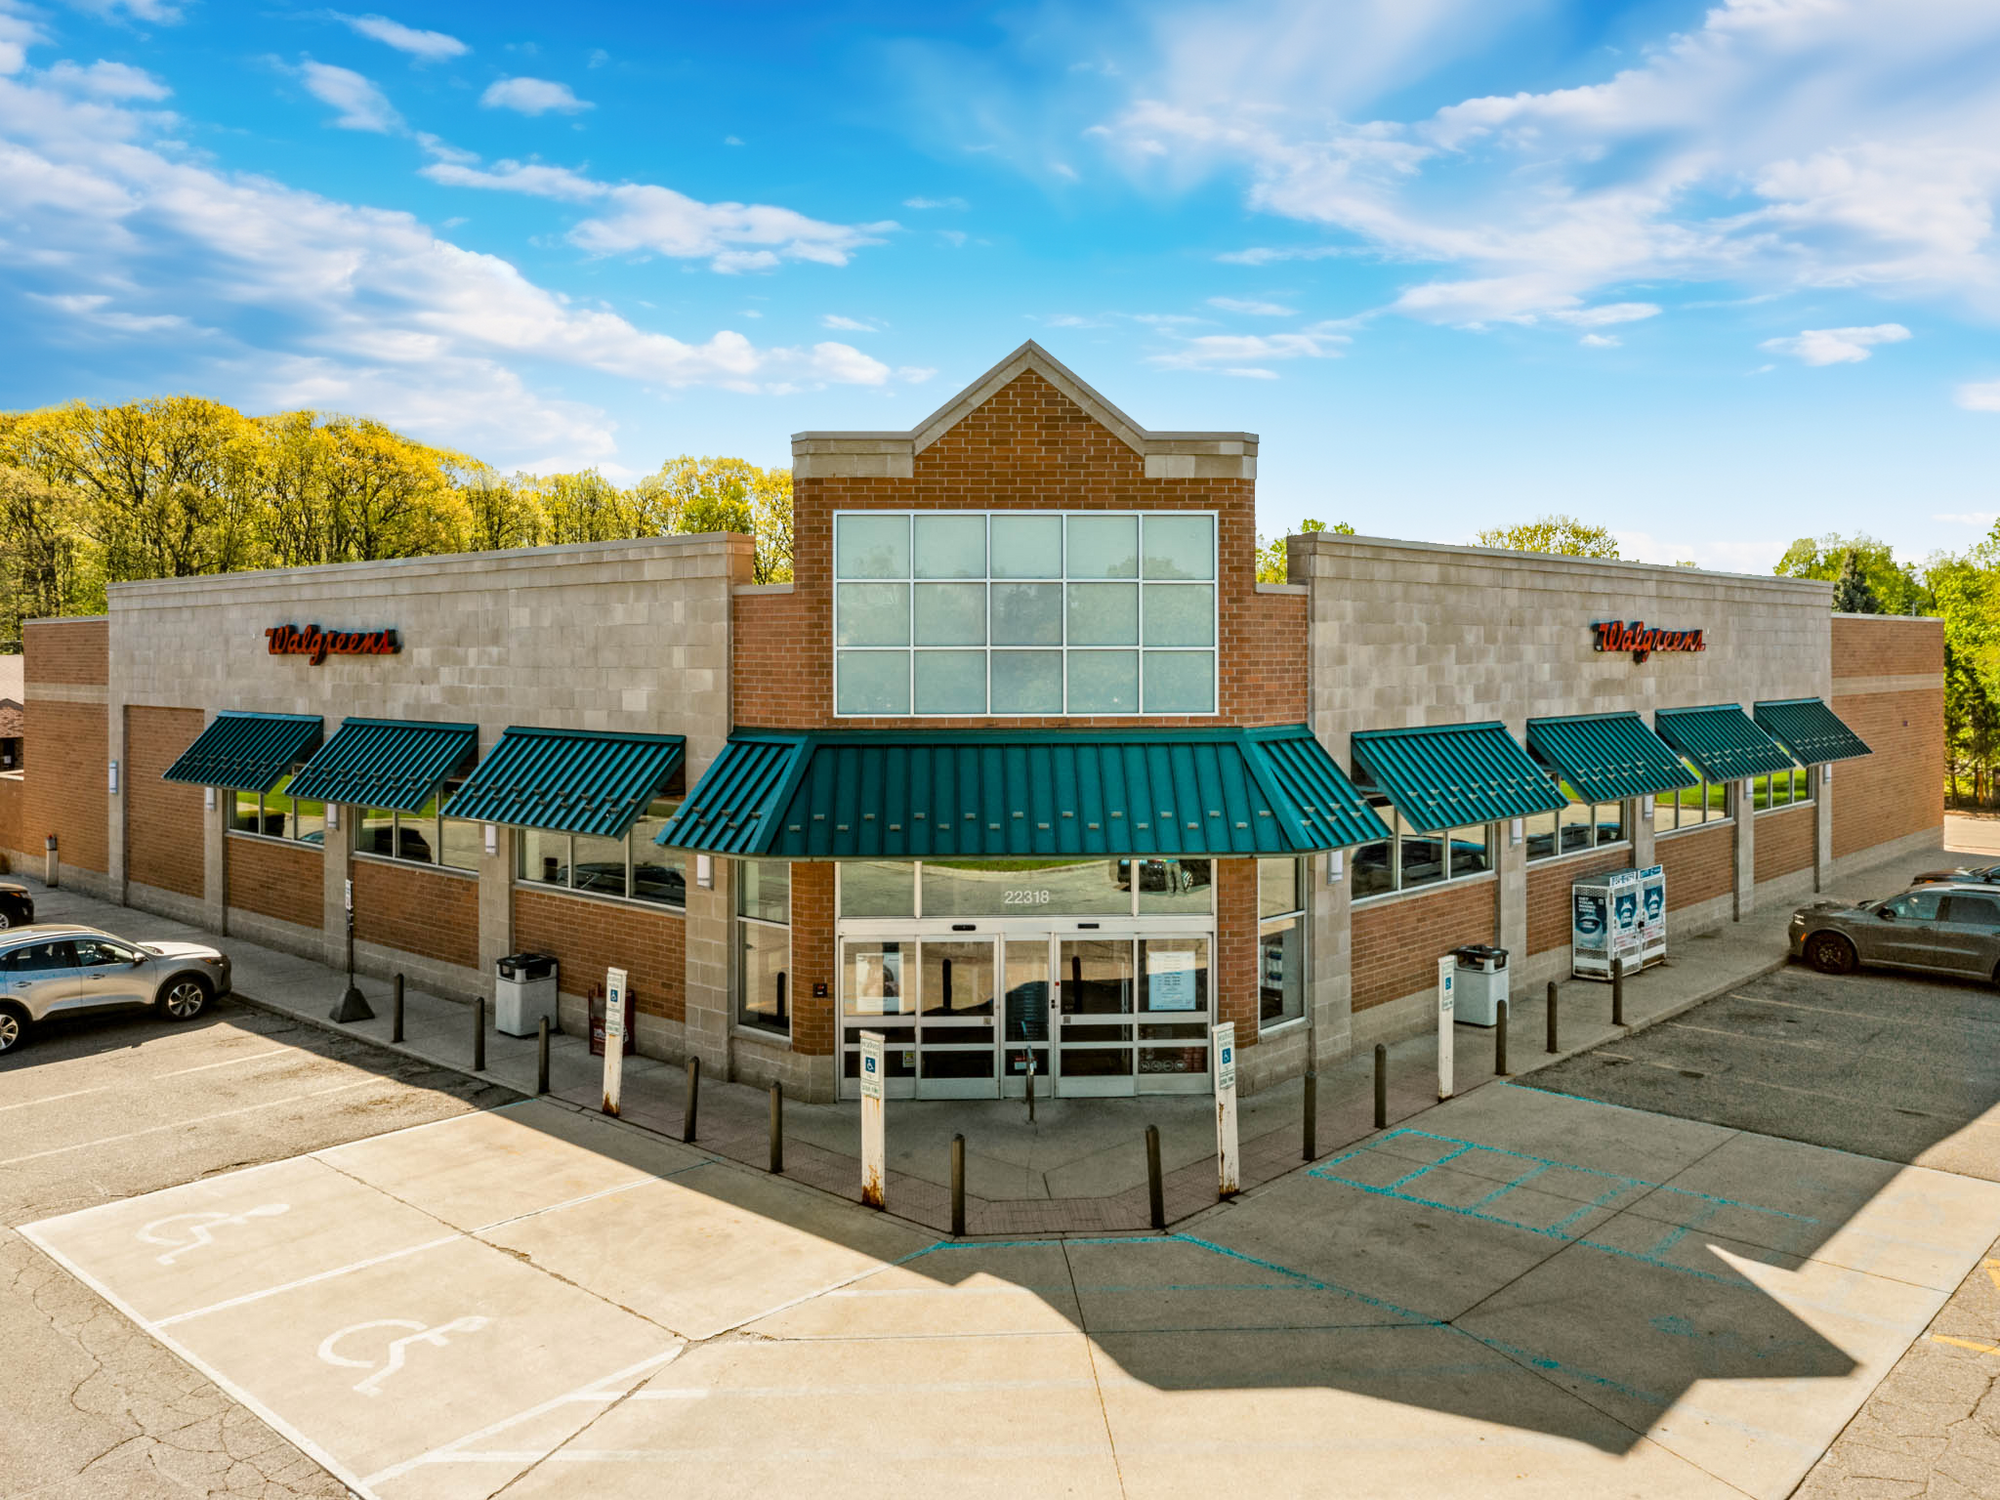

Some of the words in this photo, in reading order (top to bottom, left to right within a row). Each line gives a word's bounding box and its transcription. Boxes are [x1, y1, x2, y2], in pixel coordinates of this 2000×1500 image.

[265, 624, 401, 666] Walgreens
[1592, 620, 1706, 664] Walgreens
[1003, 890, 1050, 904] 22318
